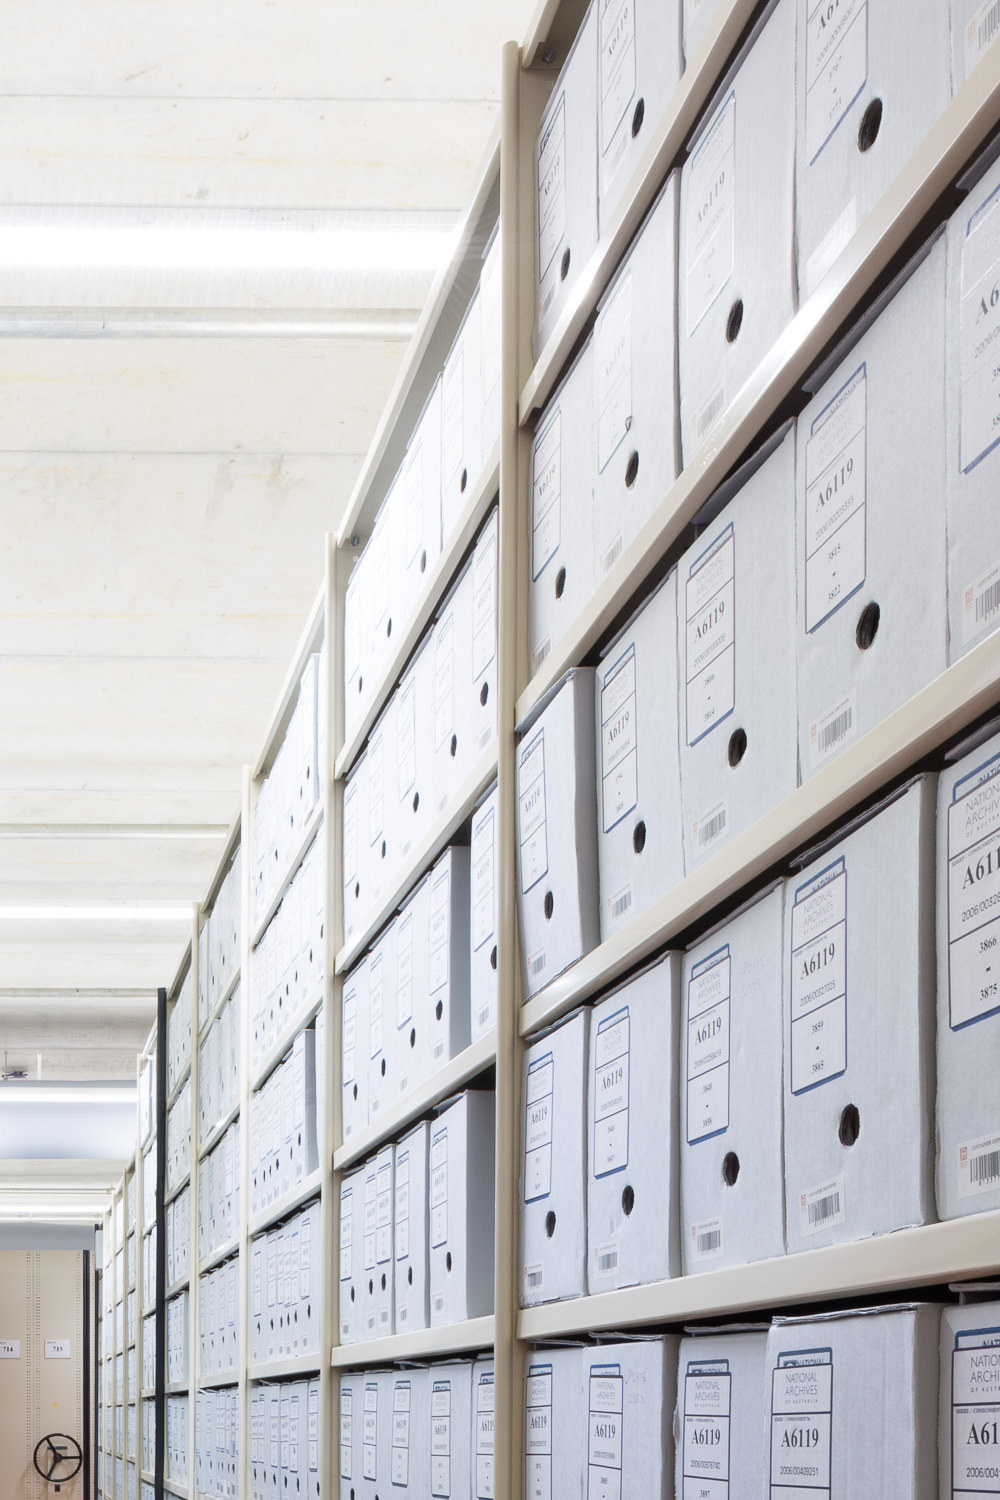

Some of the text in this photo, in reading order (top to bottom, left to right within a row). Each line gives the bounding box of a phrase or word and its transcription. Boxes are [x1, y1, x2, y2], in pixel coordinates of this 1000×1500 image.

[696, 171, 725, 224] A6119
[816, 458, 854, 513] A6119
[694, 601, 725, 644] A6119
[608, 710, 630, 745] A6119
[524, 789, 541, 815] A6119
[803, 889, 833, 914] NATIONAL
[803, 902, 833, 928] ARCHIVES
[979, 936, 997, 954] 3866
[800, 942, 835, 980] A6119
[980, 983, 998, 1001] 3875
[695, 1016, 722, 1045] A6119
[601, 1067, 623, 1091] A6119
[530, 1106, 548, 1126] A6119
[695, 1381, 720, 1390] NATIONAL
[785, 1373, 817, 1382] NATIONAL
[695, 1392, 720, 1401] ARCHIVES
[785, 1385, 817, 1396] ARCHIVES
[530, 1415, 547, 1429] A6119
[595, 1424, 616, 1438] A6119
[691, 1429, 720, 1445] A6119
[782, 1429, 819, 1447] A6119
[967, 1422, 999, 1444] A61
